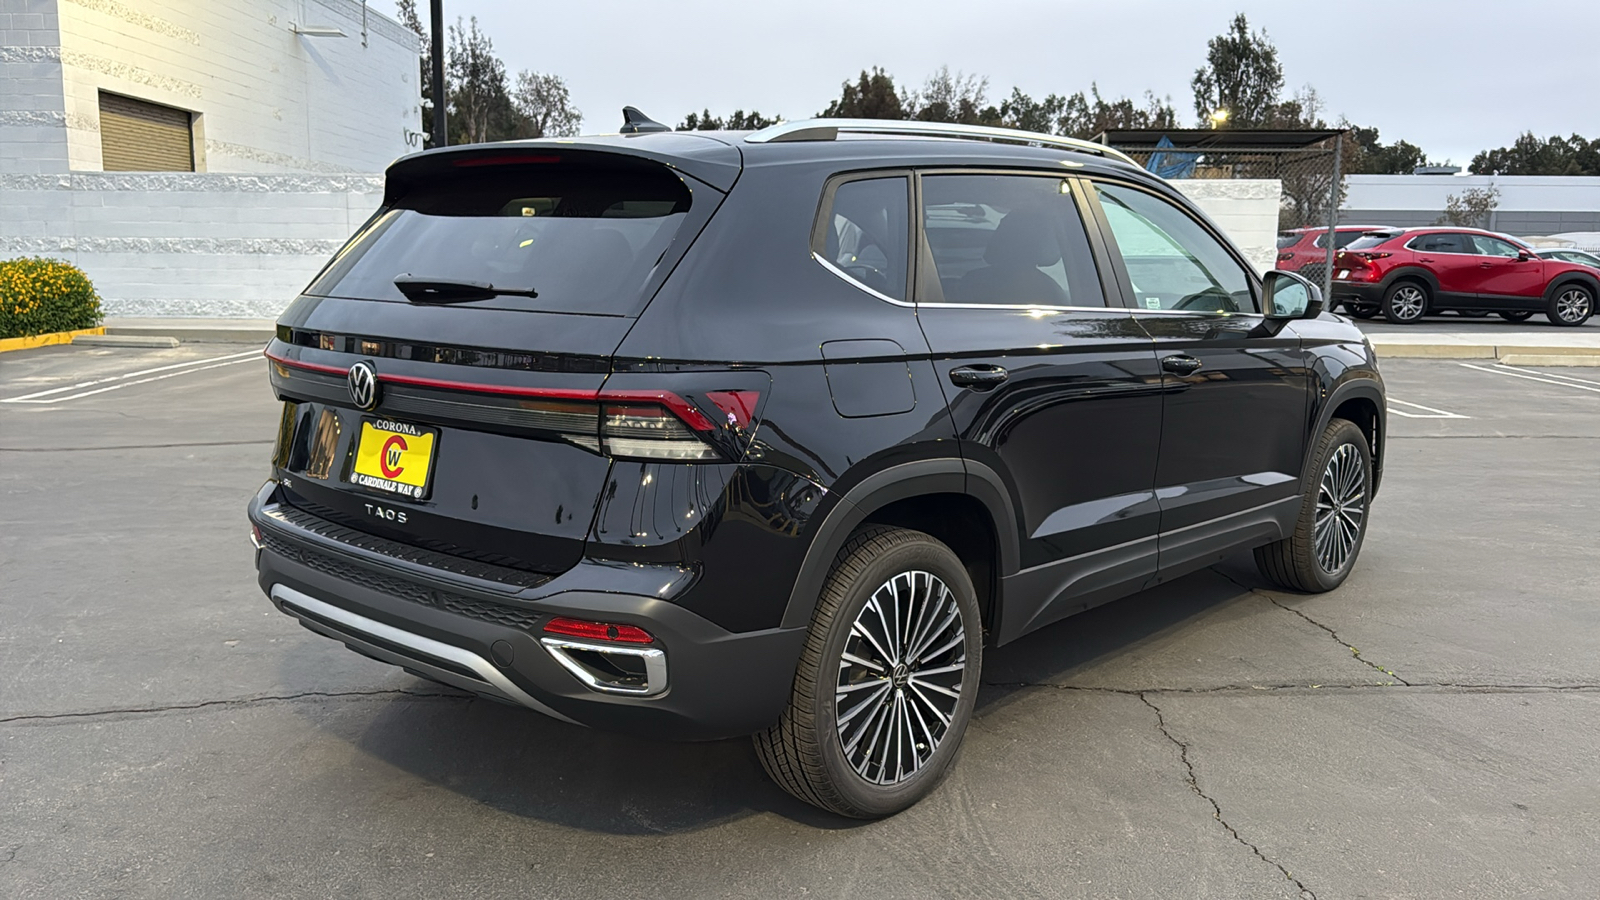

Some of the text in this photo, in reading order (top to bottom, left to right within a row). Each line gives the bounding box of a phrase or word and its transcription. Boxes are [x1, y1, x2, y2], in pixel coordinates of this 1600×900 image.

[376, 419, 416, 435] CORONA
[358, 475, 397, 493] CARDINALE
[397, 483, 414, 496] WAY
[364, 503, 409, 524] TAOS
